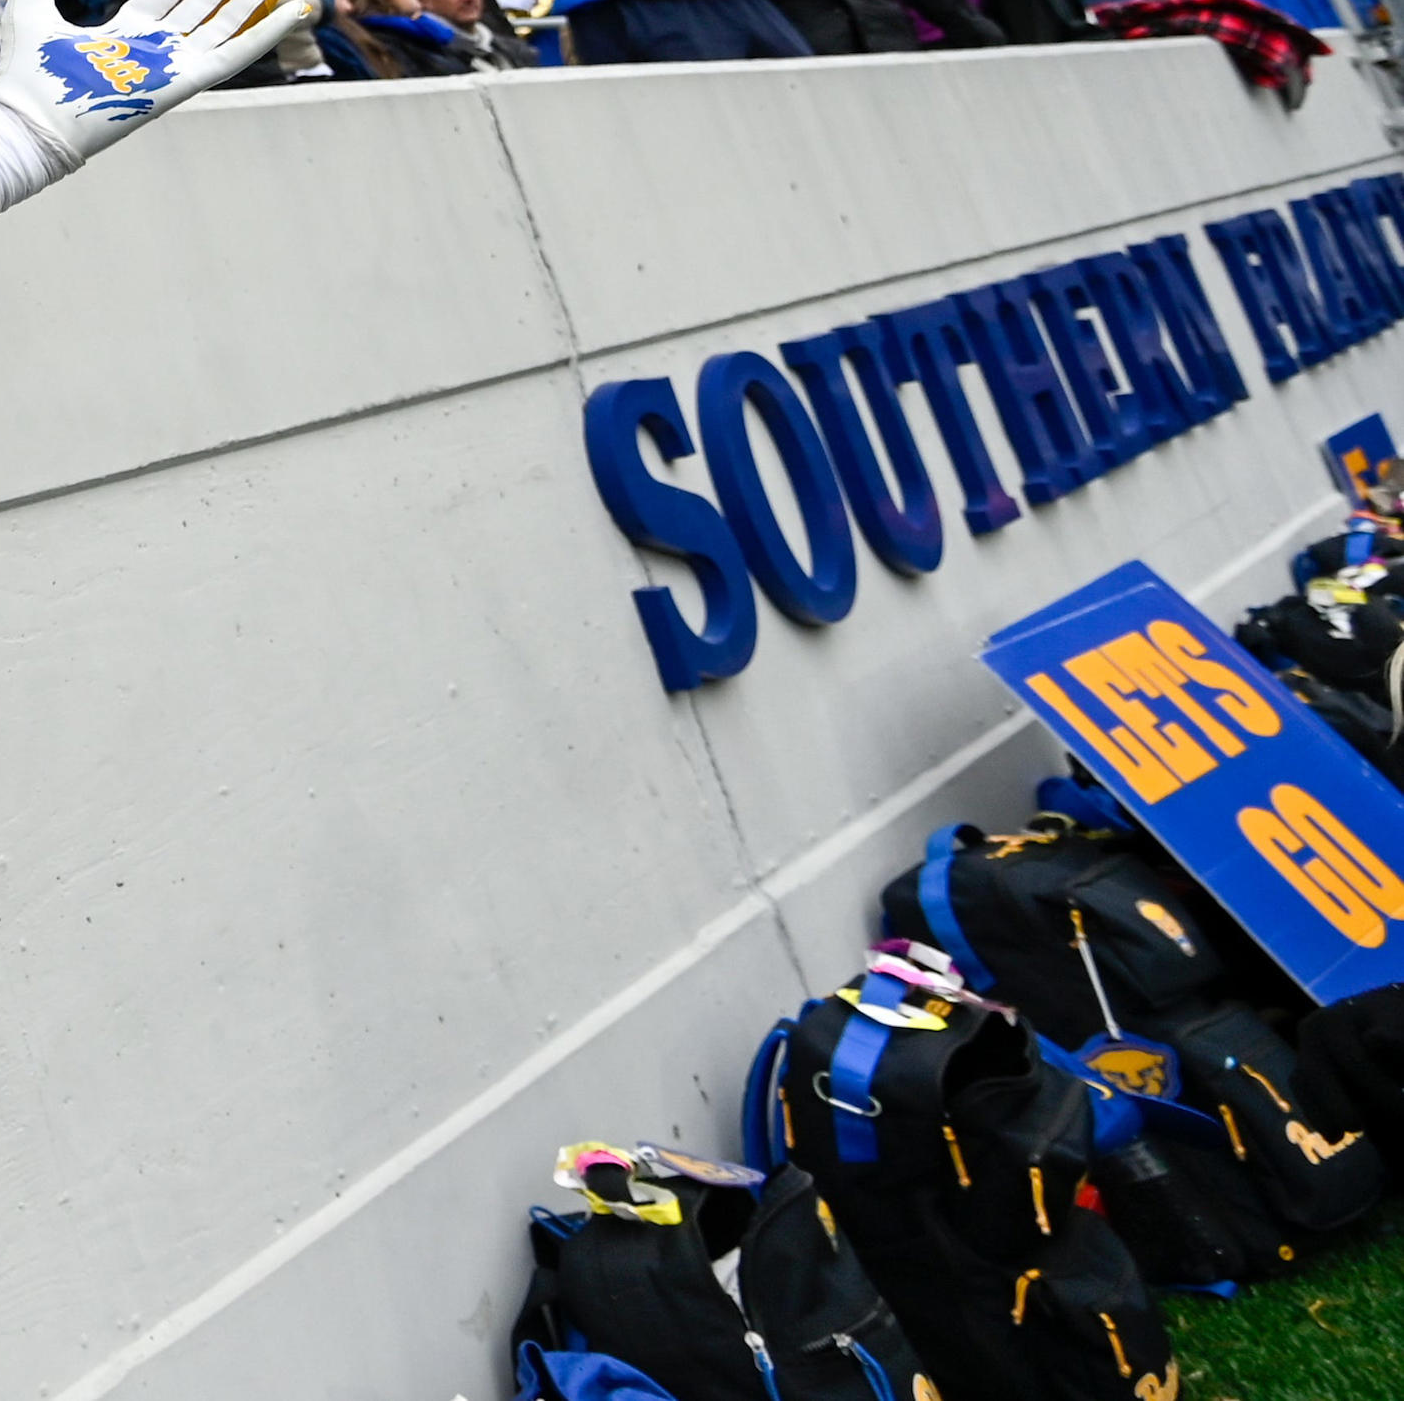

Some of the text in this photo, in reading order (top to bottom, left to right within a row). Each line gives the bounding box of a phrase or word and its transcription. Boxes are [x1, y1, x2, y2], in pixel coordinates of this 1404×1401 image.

[74, 37, 150, 93] Pitt
[584, 233, 1250, 692] SOUTHERN
[1025, 620, 1282, 805] LETS
[1237, 783, 1404, 949] GO
